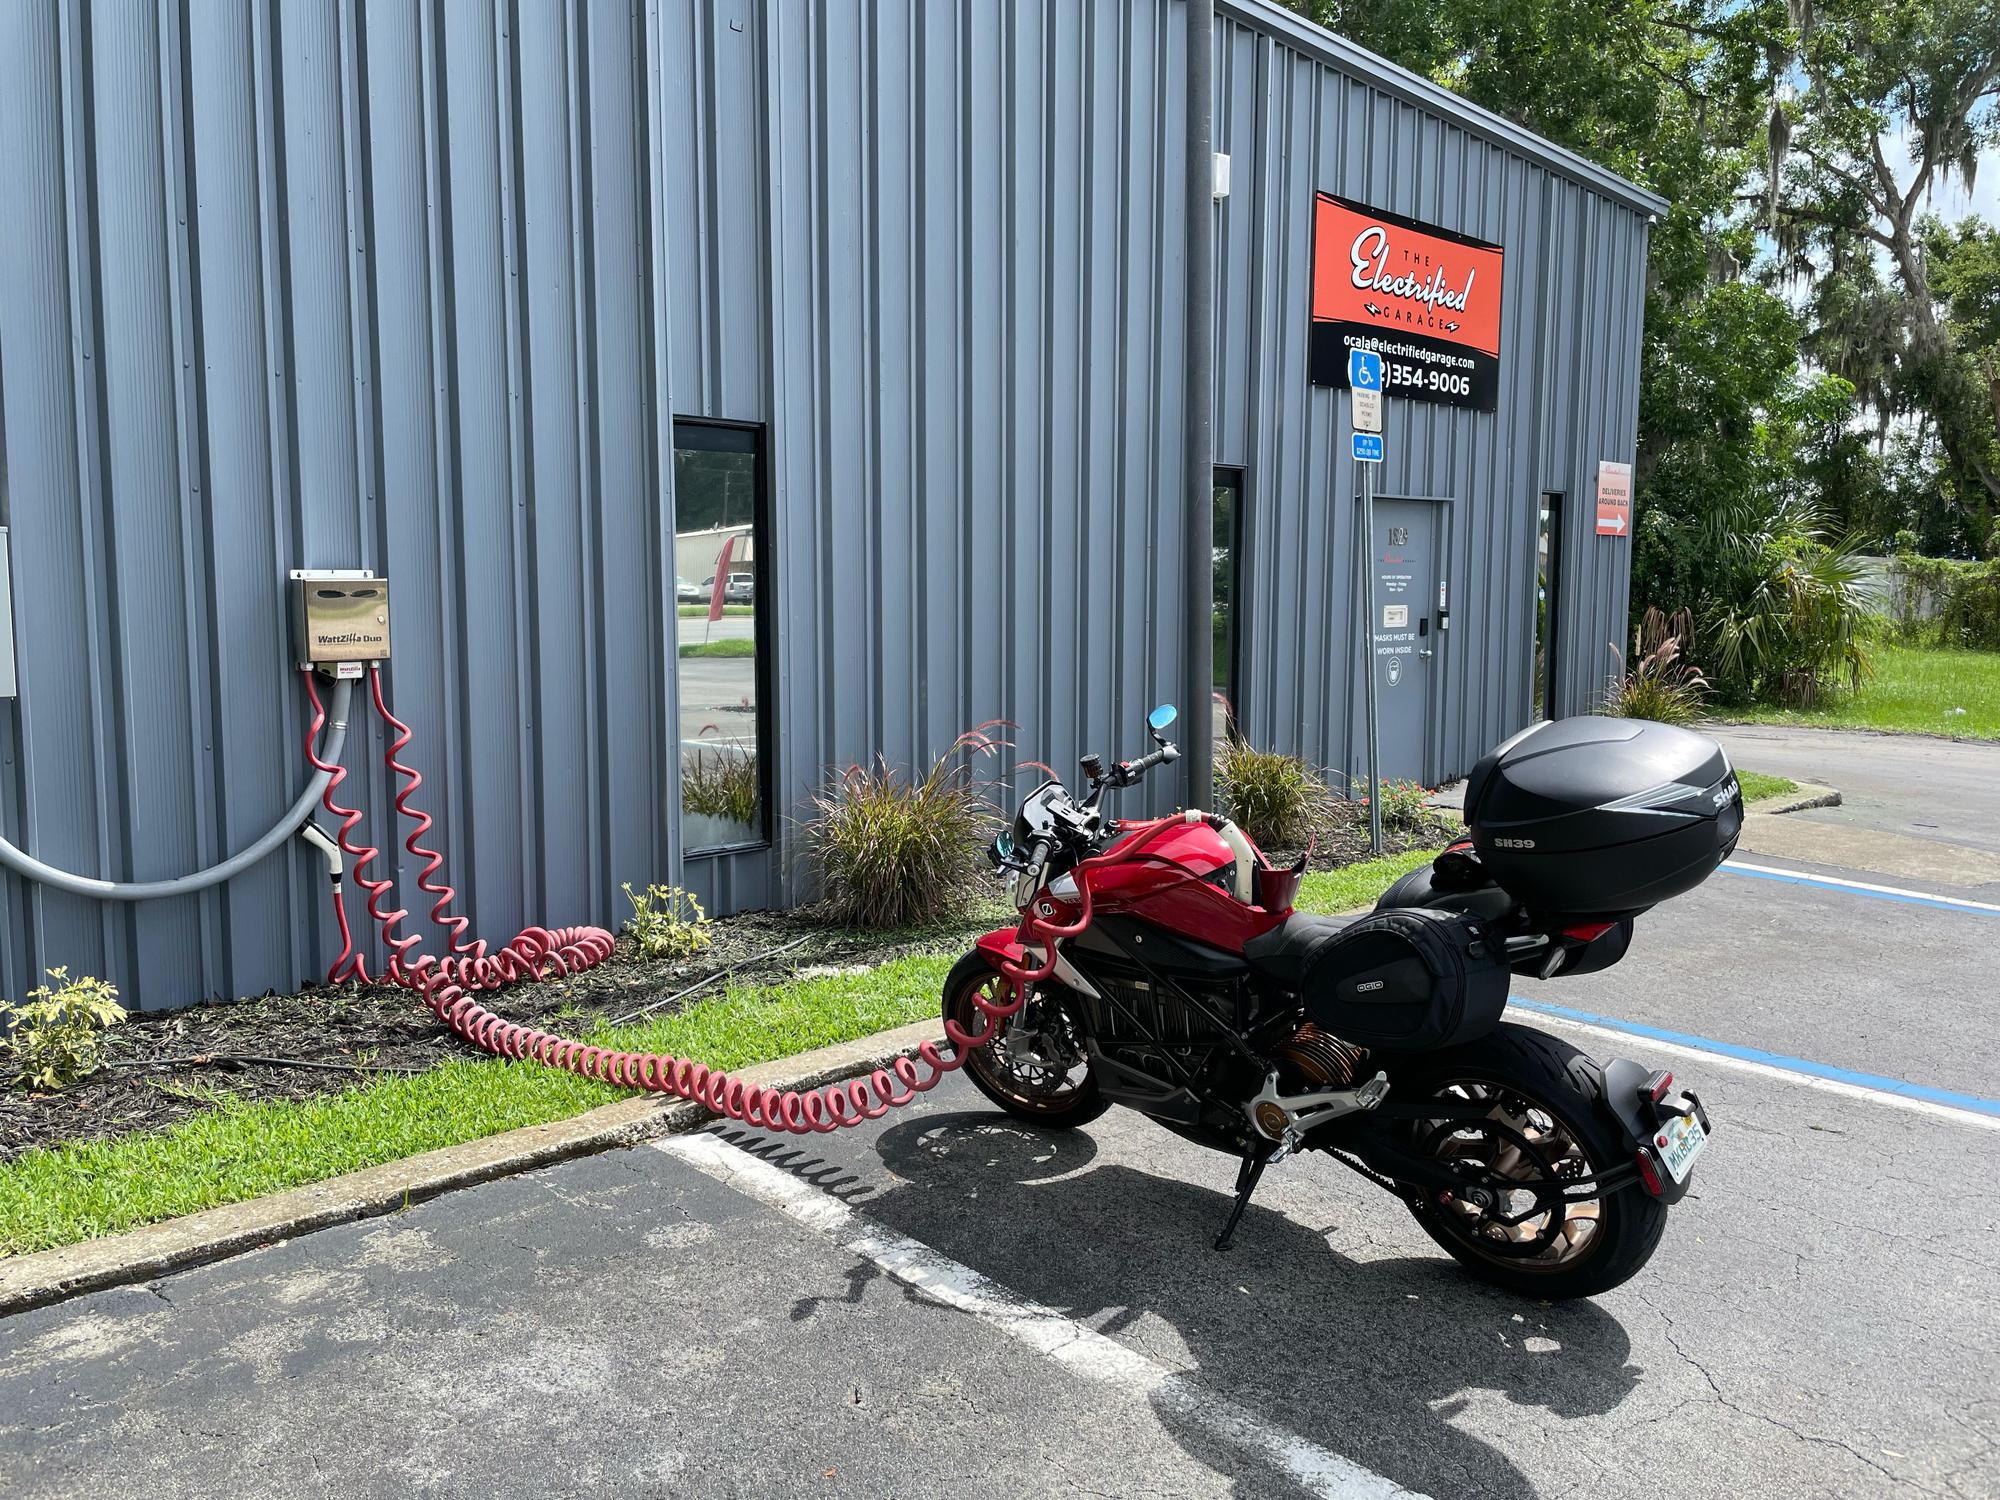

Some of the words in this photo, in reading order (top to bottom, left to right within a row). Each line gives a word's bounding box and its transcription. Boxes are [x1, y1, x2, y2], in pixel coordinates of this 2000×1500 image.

[1404, 250, 1430, 266] THE
[1351, 226, 1475, 314] Electrified
[1383, 306, 1443, 330] GARAGE
[1343, 335, 1475, 370] ocala@electrifiedgarage.com
[1347, 358, 1470, 396] ()354-9006
[363, 635, 382, 643] Duo
[1374, 634, 1393, 642] MASKS
[1393, 633, 1408, 641] MUST
[1408, 632, 1415, 641] BE
[1377, 647, 1394, 655] WORN
[1395, 646, 1412, 654] INSIDE
[1713, 780, 1738, 807] SHAD
[1494, 837, 1536, 849] SH39
[1357, 980, 1384, 992] OGIO
